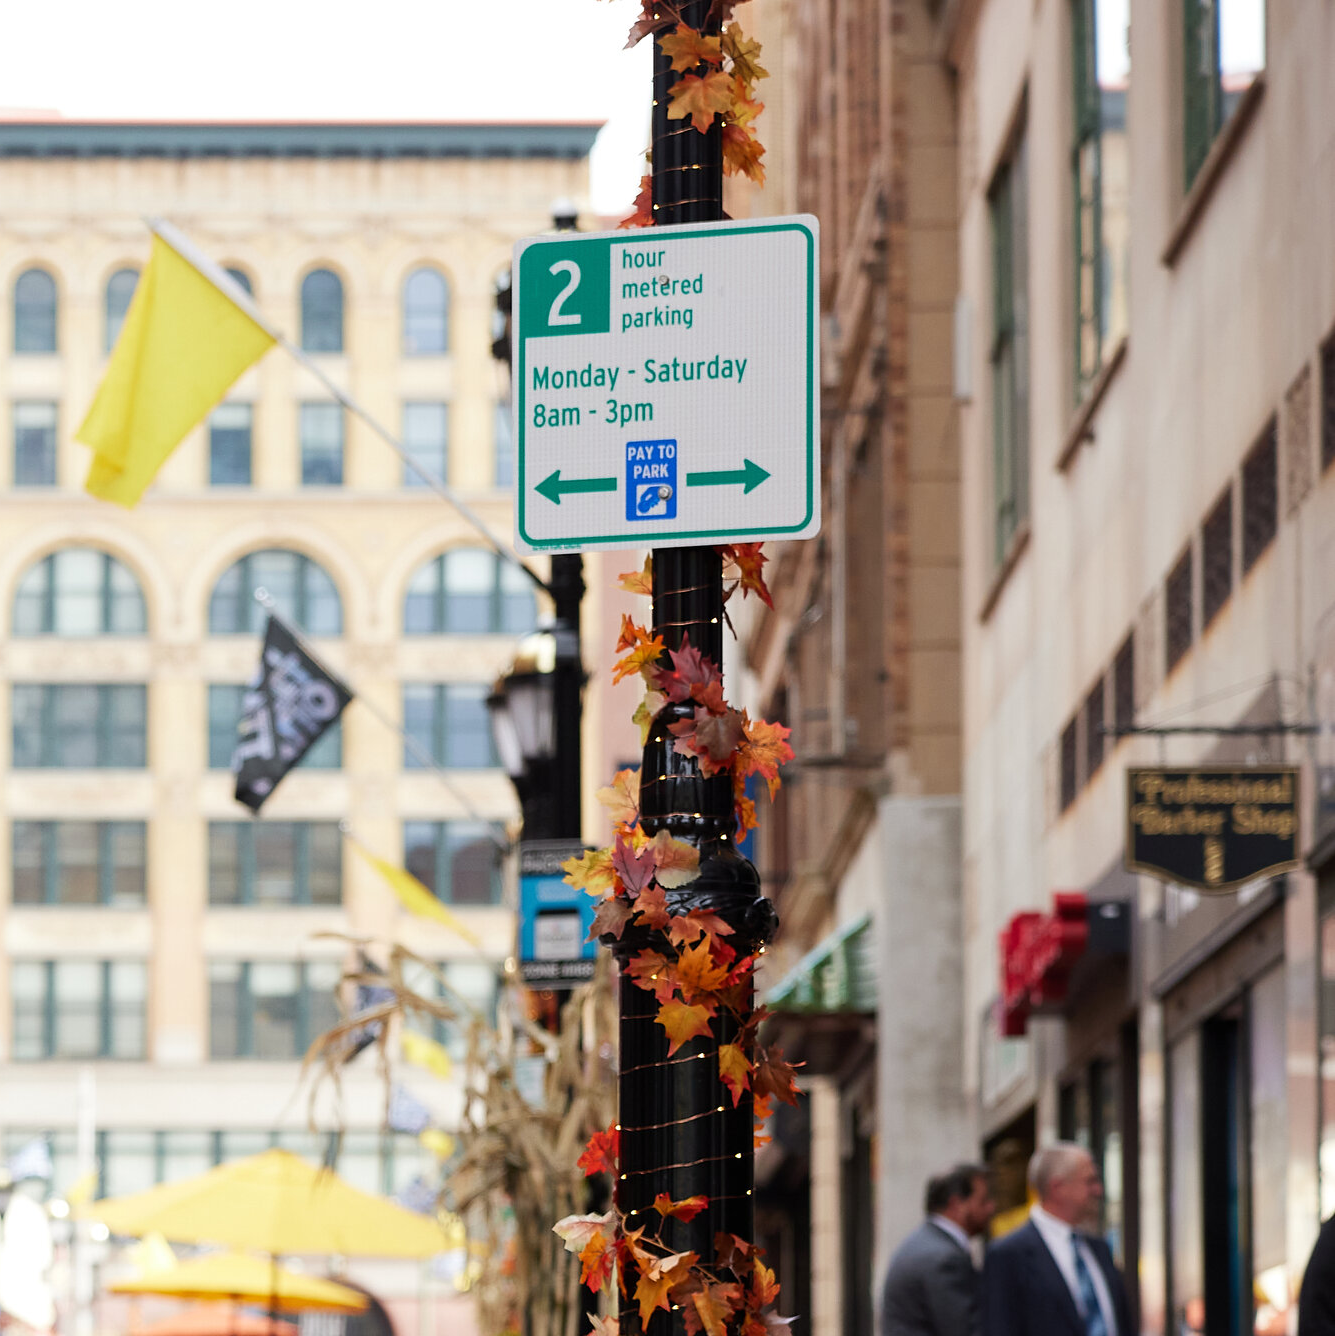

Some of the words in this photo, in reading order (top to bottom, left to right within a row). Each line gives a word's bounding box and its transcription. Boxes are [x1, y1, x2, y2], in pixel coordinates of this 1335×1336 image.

[622, 249, 666, 269] hour
[547, 260, 582, 327] 2
[622, 274, 703, 299] metered
[622, 306, 694, 333] parking
[532, 363, 620, 392] Monday
[644, 355, 748, 384] Saturday
[532, 404, 581, 429] 8am
[605, 399, 654, 428] 3pm
[627, 446, 654, 461] PAY
[657, 445, 675, 459] TO
[633, 464, 669, 479] PARK
[1136, 773, 1292, 805] Professional
[1131, 802, 1227, 836] Barber
[1232, 802, 1298, 841] Shop
